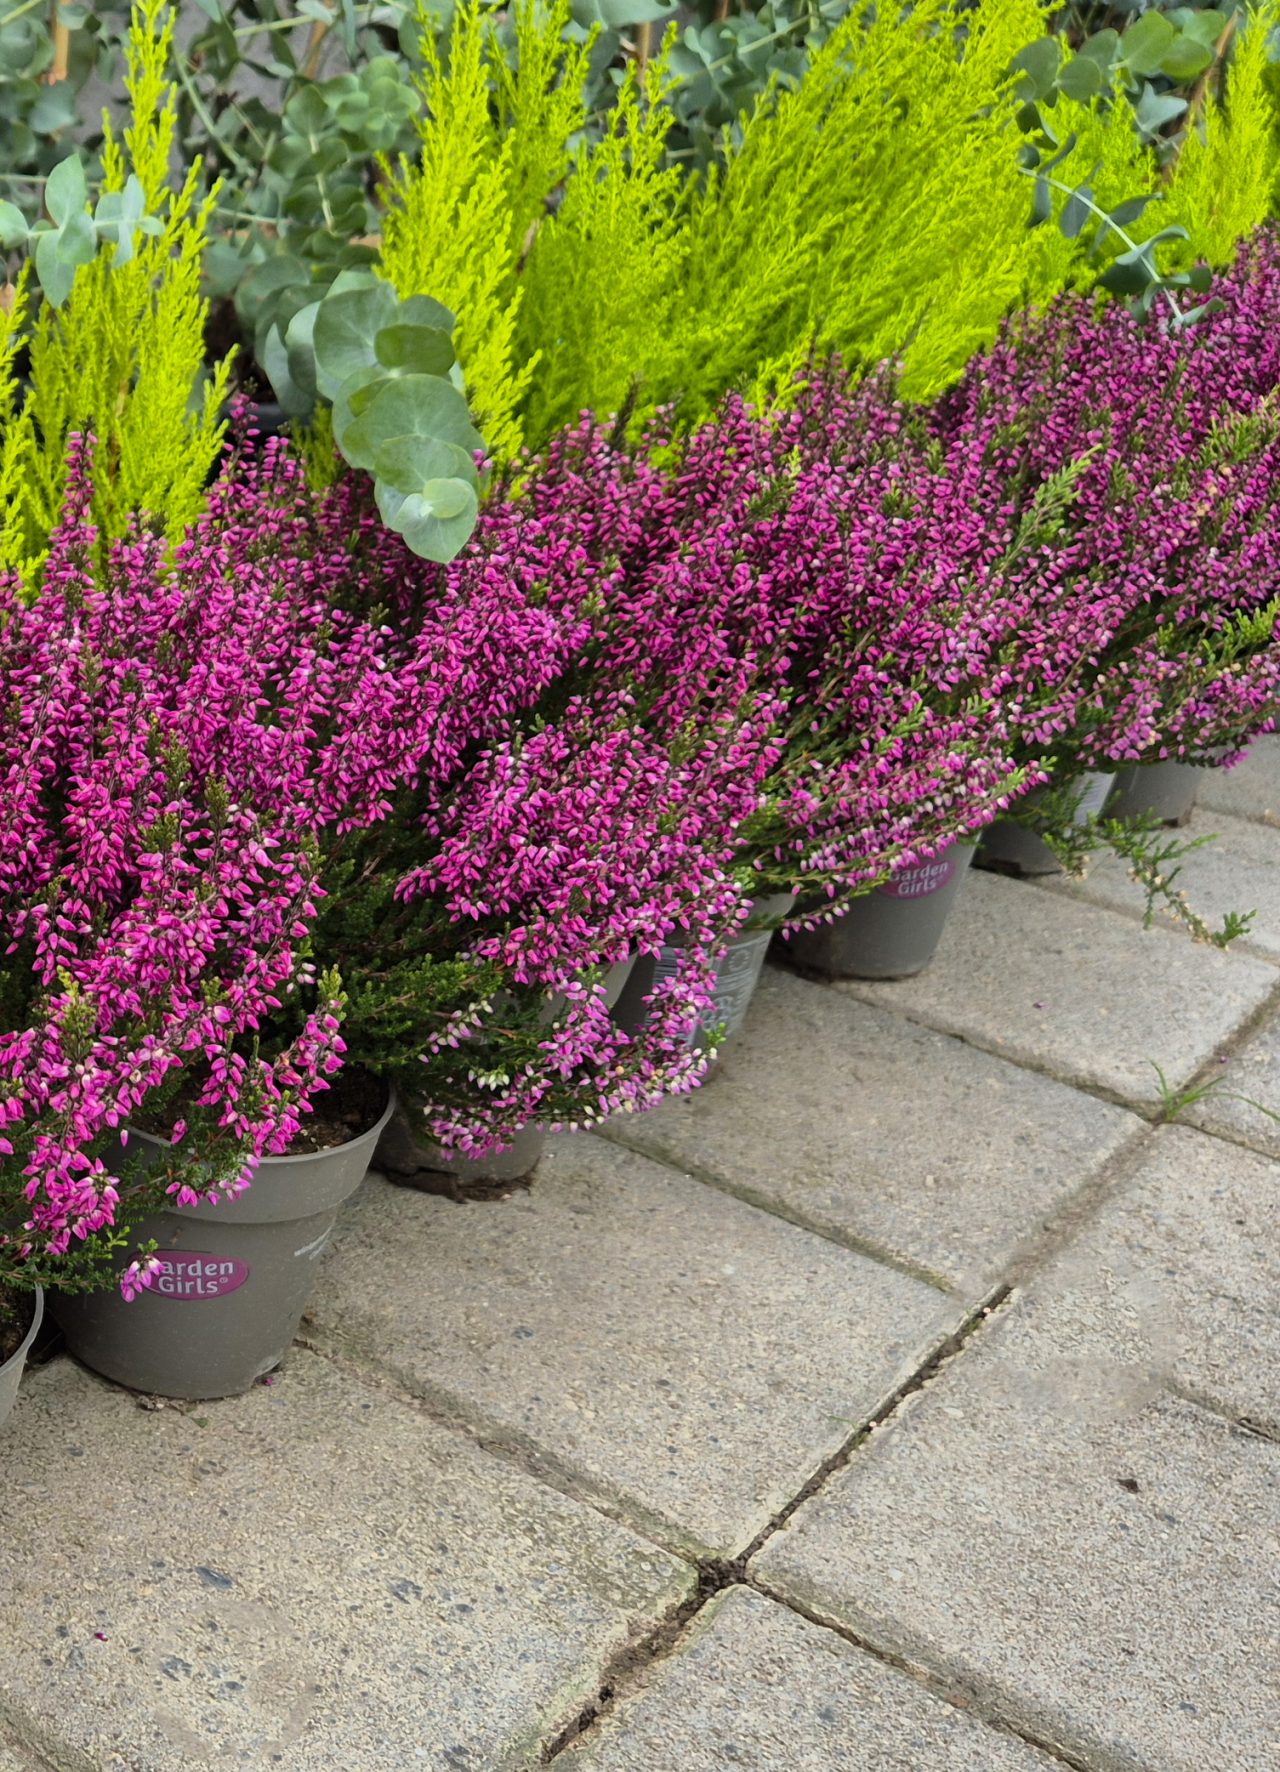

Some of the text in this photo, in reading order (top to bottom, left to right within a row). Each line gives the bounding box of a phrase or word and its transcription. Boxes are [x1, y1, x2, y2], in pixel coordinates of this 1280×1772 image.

[898, 878, 937, 895] Girls
[161, 1259, 234, 1276] arden
[158, 1277, 218, 1294] Girls
